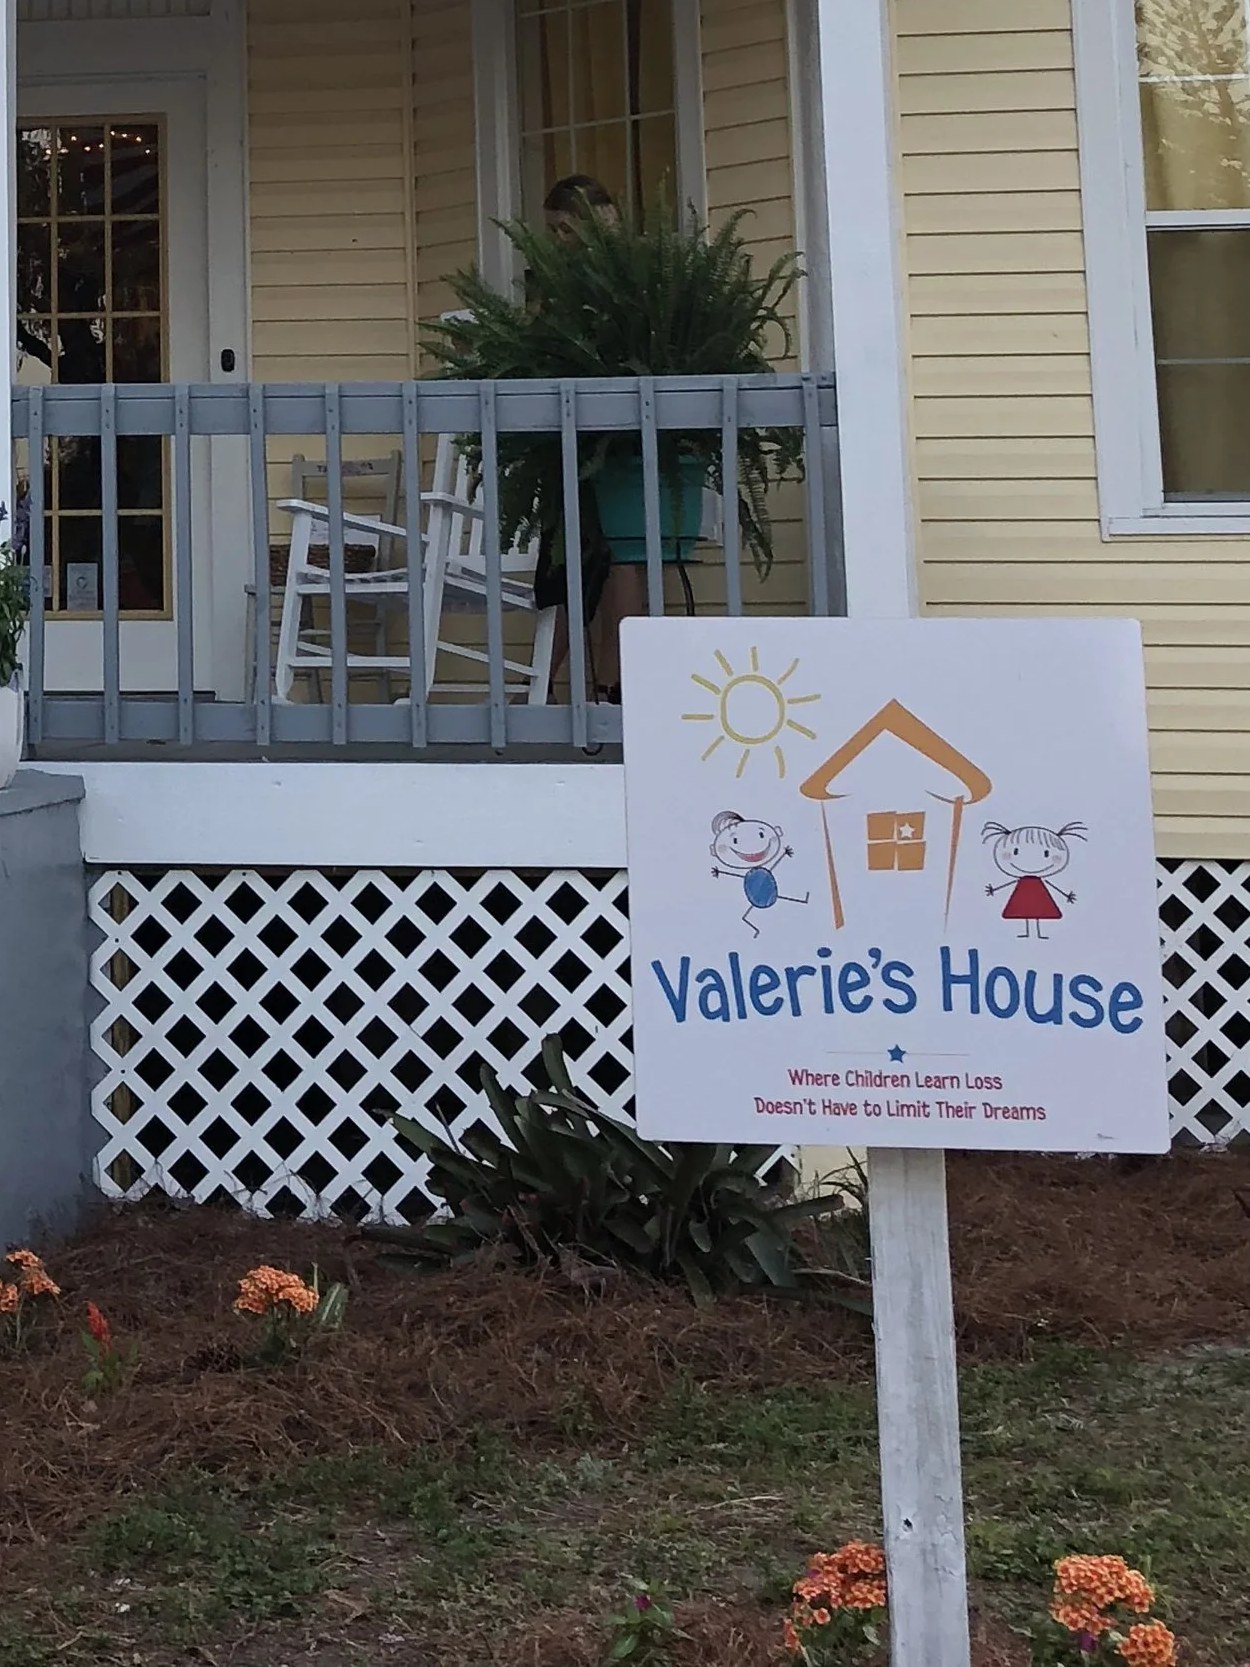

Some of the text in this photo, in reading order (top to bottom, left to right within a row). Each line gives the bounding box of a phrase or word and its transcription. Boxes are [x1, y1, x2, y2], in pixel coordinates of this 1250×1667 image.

[650, 946, 1143, 1034] Valerie's House
[788, 1069, 1003, 1091] Where Children Learn Loss
[754, 1097, 1046, 1121] Doesn't Have to Limit Their Dreams
